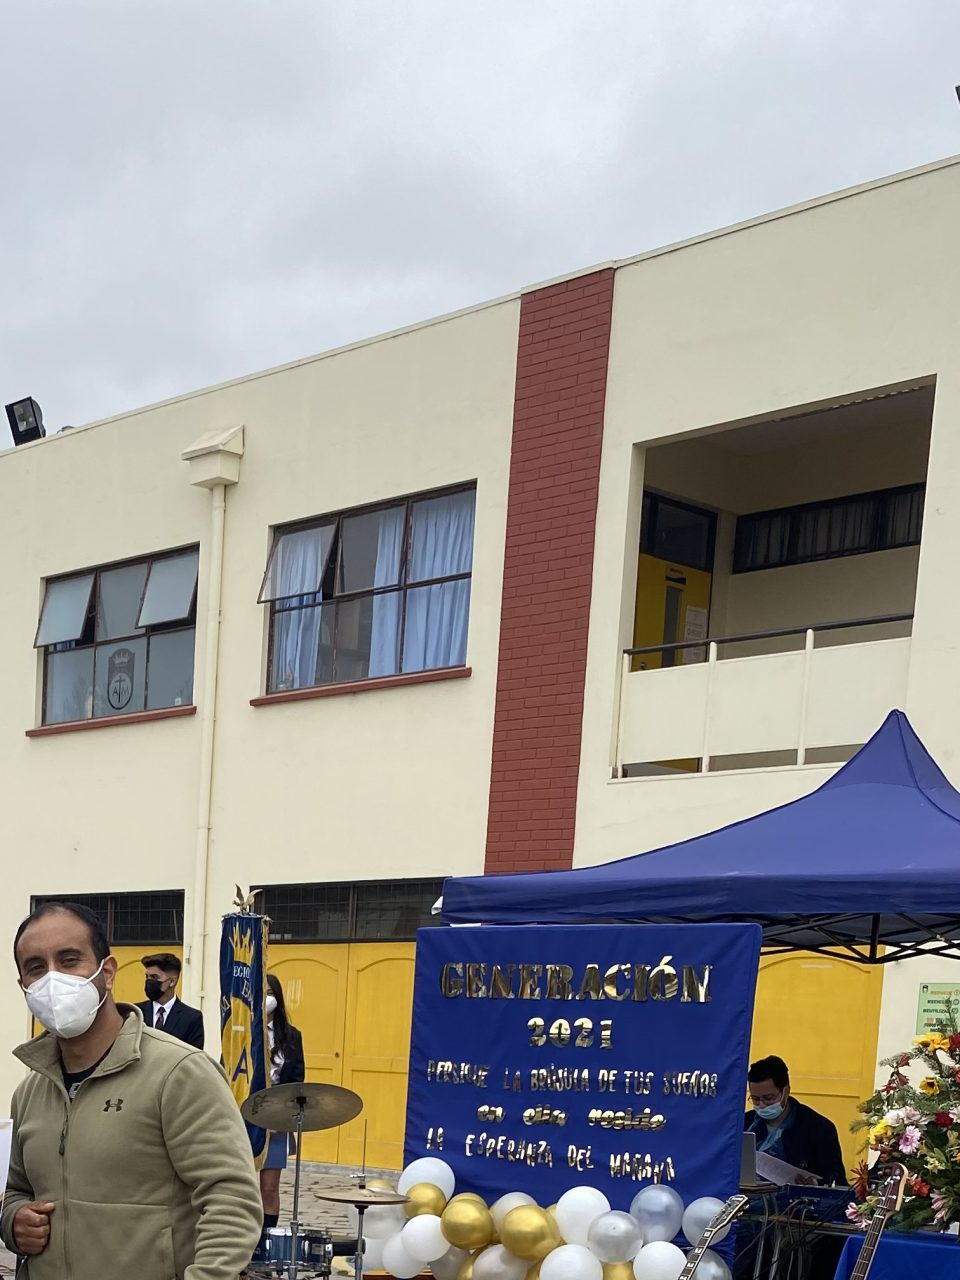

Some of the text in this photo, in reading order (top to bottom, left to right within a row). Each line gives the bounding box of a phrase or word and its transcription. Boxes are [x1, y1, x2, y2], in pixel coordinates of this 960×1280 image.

[441, 955, 713, 1003] GENERACIÓN
[527, 1017, 614, 1049] 2021
[427, 1059, 489, 1089] PERSIGUE
[503, 1067, 521, 1092] LA
[598, 1069, 618, 1093] DE
[623, 1070, 654, 1095] TUS
[663, 1070, 718, 1098] SUEÑOS
[426, 1127, 676, 1185] LA ESPERANZA DEL MAÑANA
